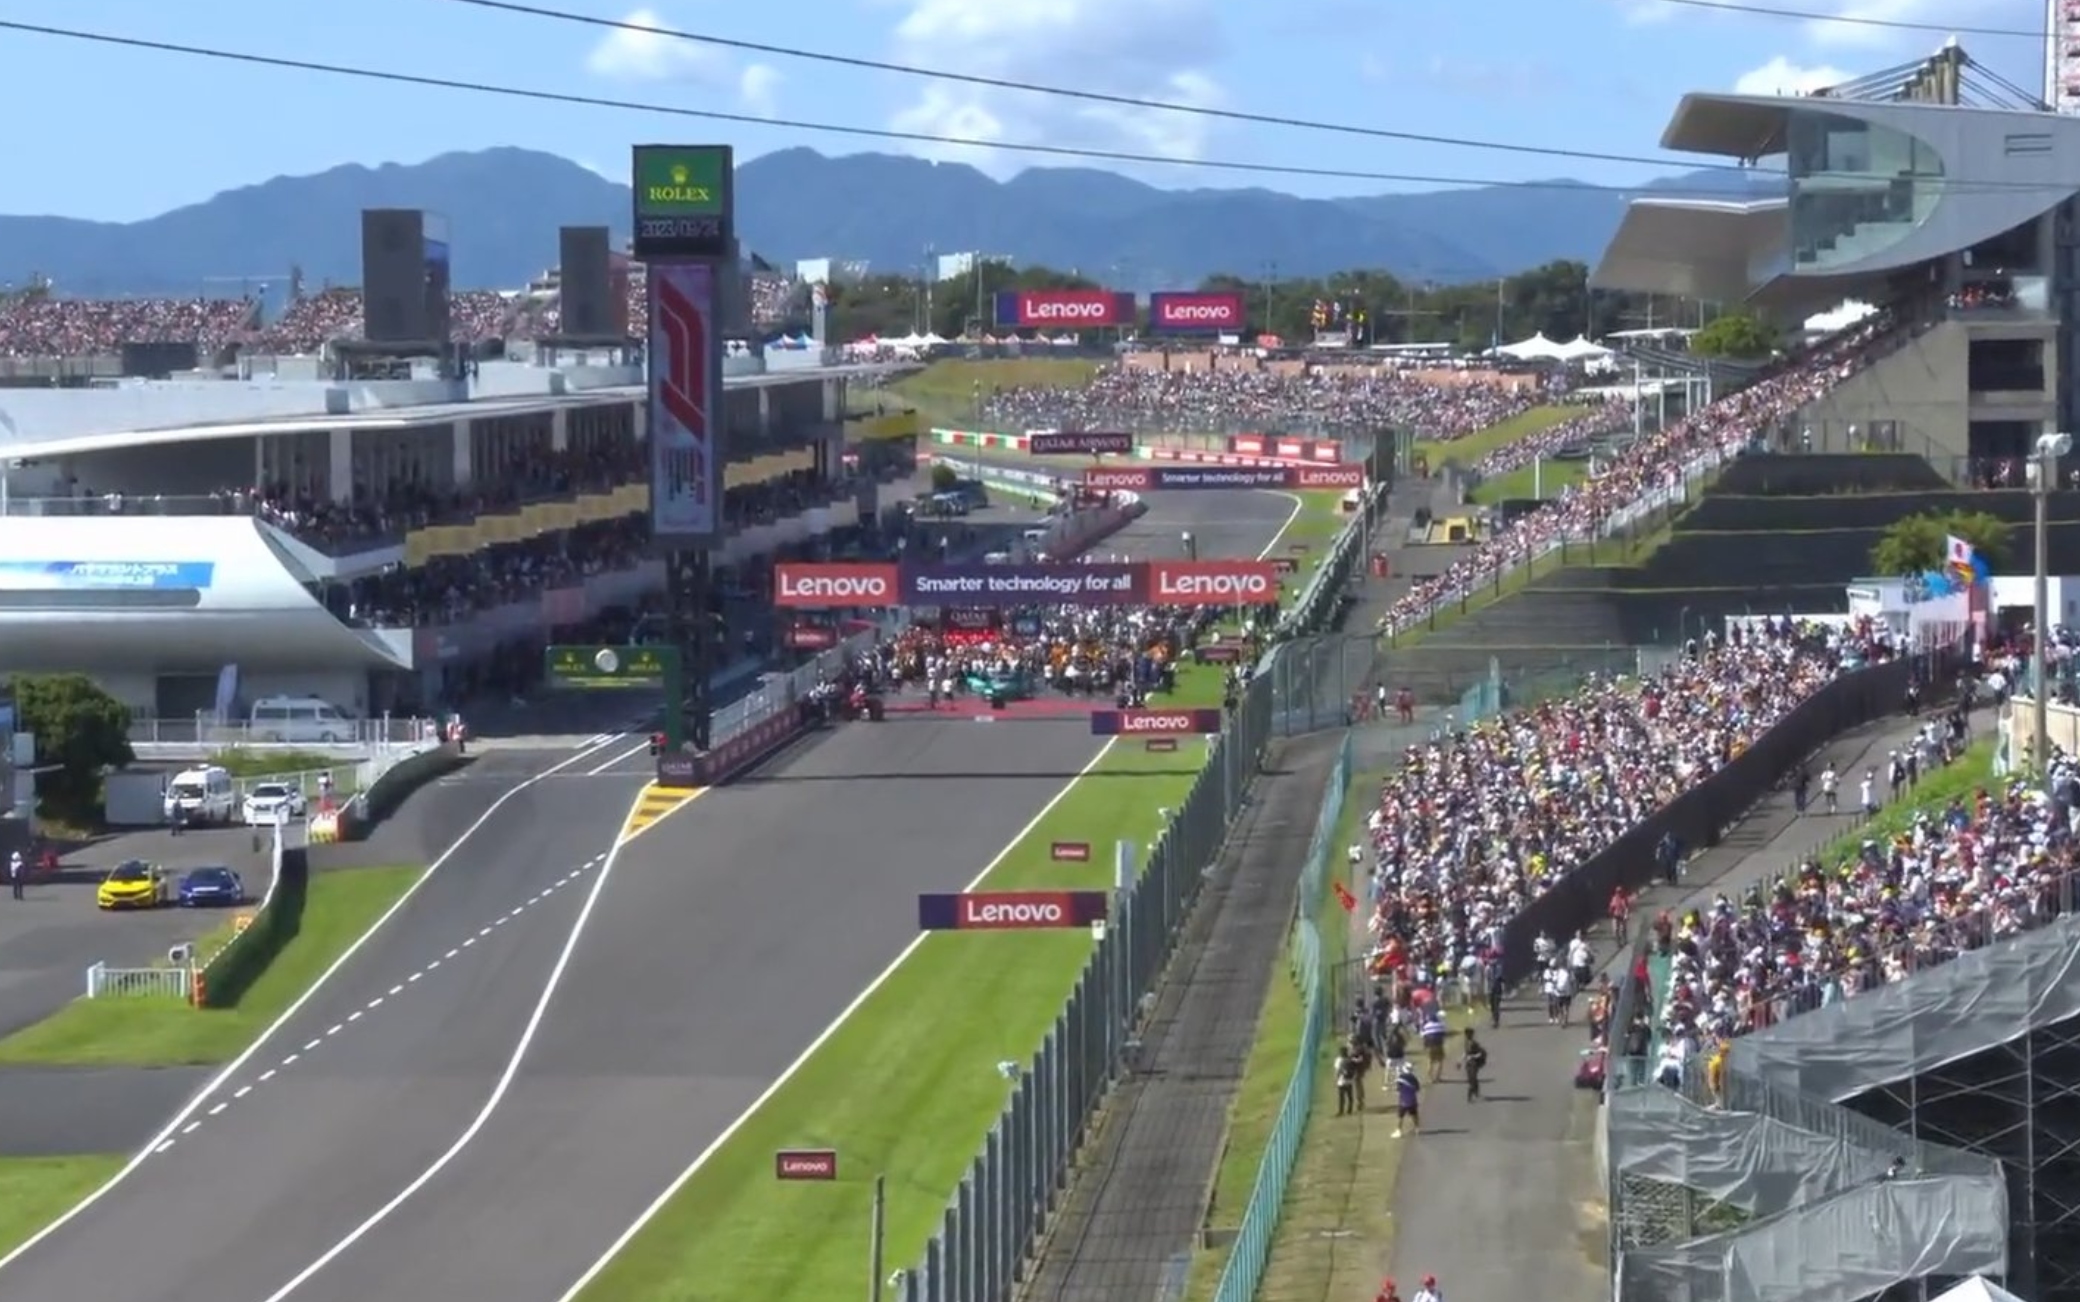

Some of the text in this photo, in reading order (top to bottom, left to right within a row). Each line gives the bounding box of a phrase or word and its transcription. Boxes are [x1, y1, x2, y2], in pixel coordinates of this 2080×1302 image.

[650, 186, 710, 200] ROLEX
[1026, 299, 1105, 318] Lenovo
[1164, 303, 1231, 319] Lenovo
[1033, 435, 1130, 449] QATAR AIRWAYS
[1086, 472, 1146, 486] Lenovo
[1162, 471, 1285, 485] Smarter technology for all
[1300, 471, 1360, 485] Lenovo
[781, 571, 886, 597] Lenovo
[916, 573, 1131, 594] Smarter technology for all
[1160, 570, 1267, 595] Lenovo
[1123, 714, 1189, 730] Lenovo
[967, 899, 1062, 923] Lenovo
[783, 1160, 829, 1173] Lenovo
